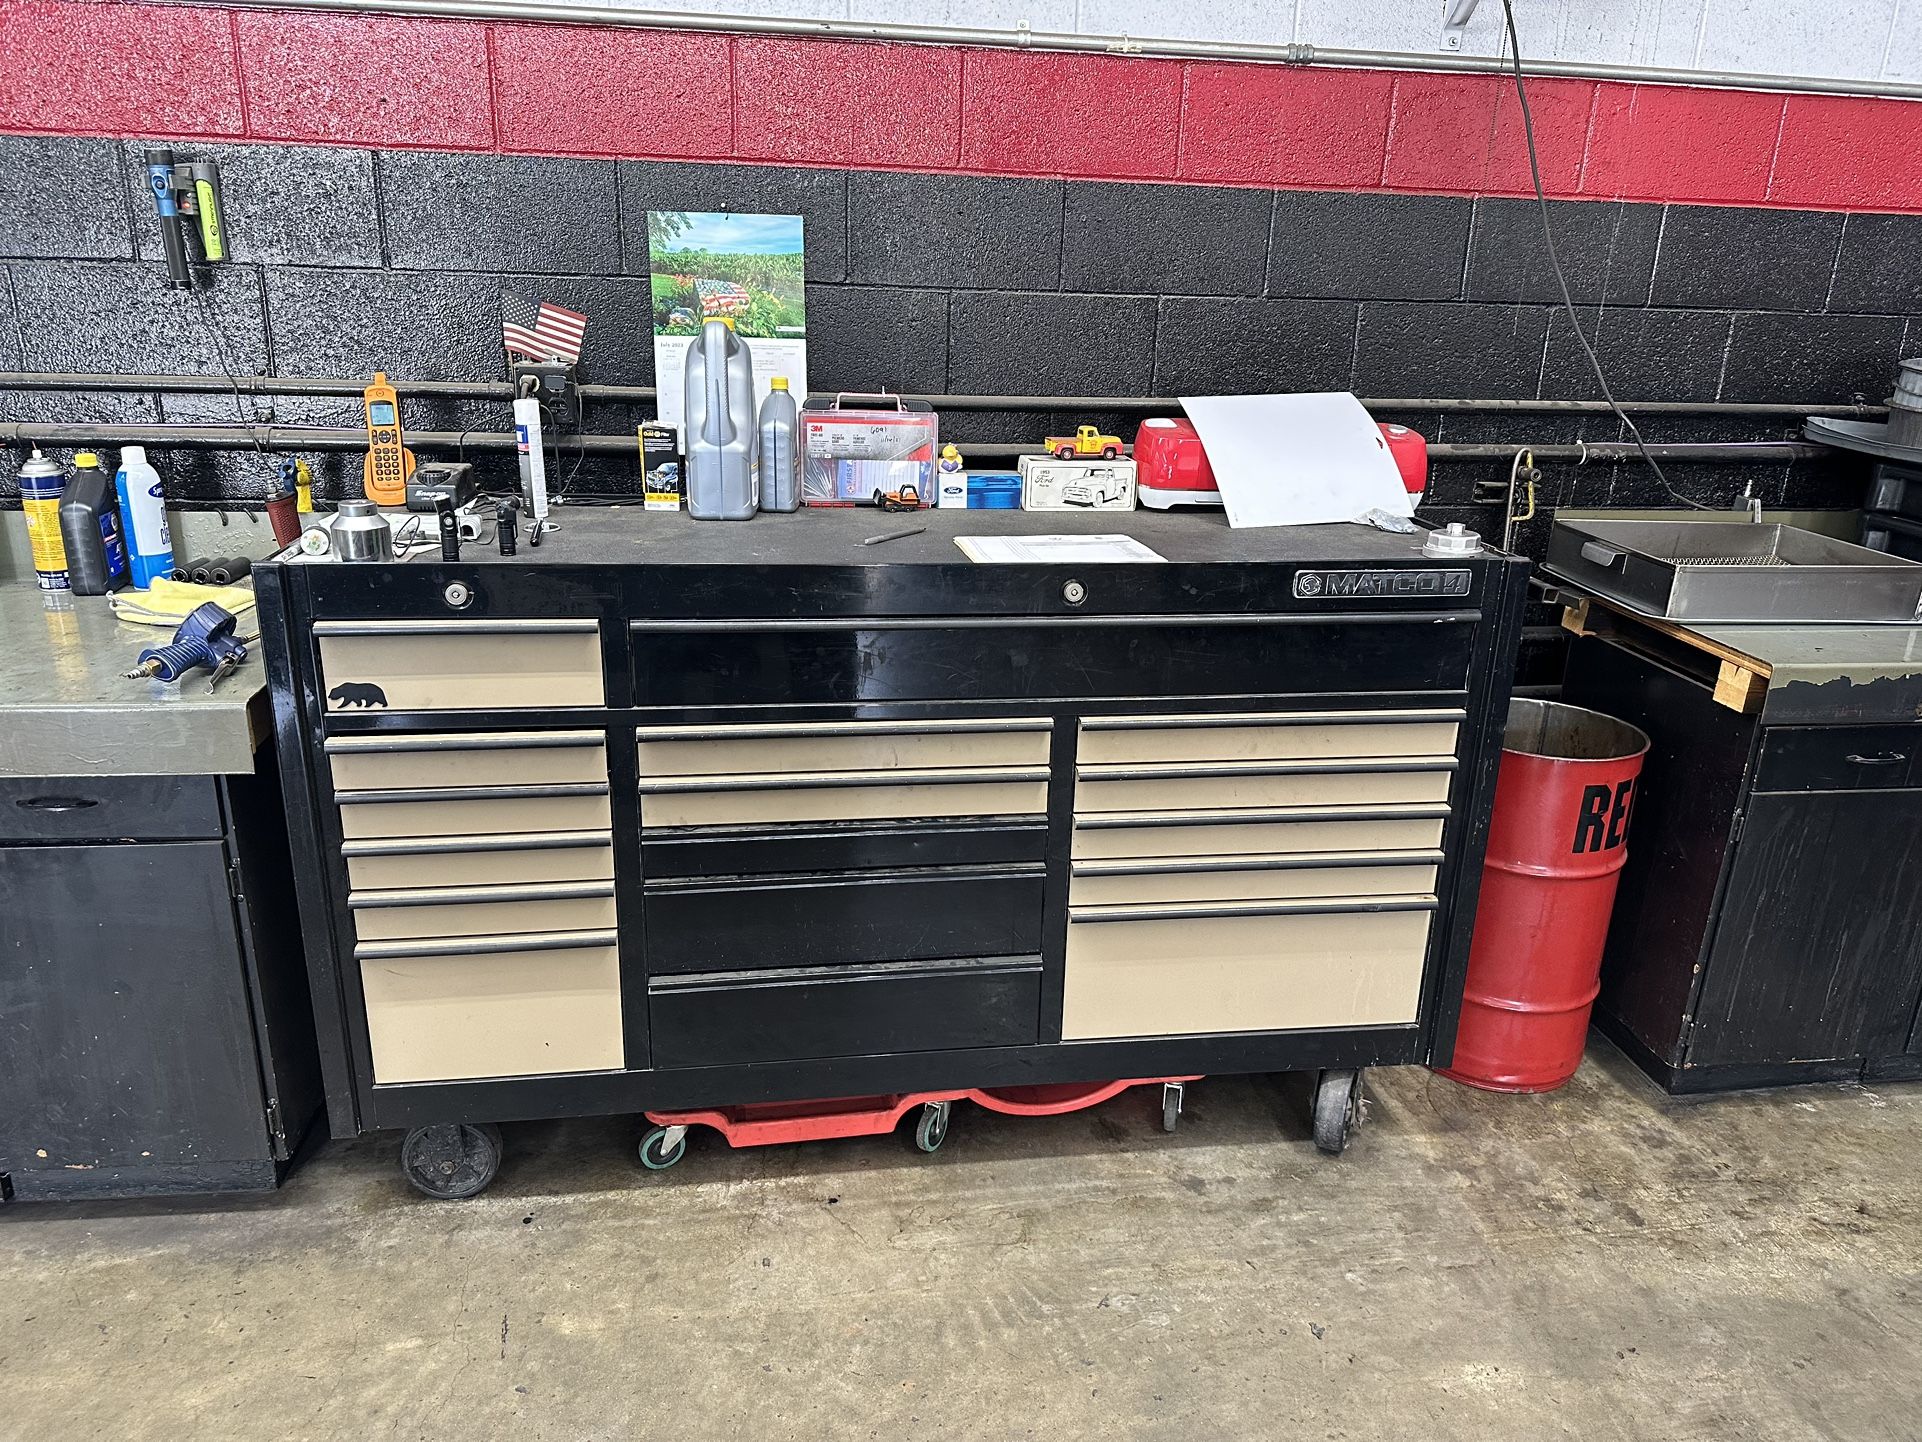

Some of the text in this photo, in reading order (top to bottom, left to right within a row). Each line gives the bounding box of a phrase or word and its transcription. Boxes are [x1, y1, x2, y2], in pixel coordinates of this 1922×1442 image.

[660, 341, 671, 349] July
[1034, 474, 1055, 484] Ford
[1325, 572, 1440, 596] MATCO
[1571, 780, 1635, 853] RE
